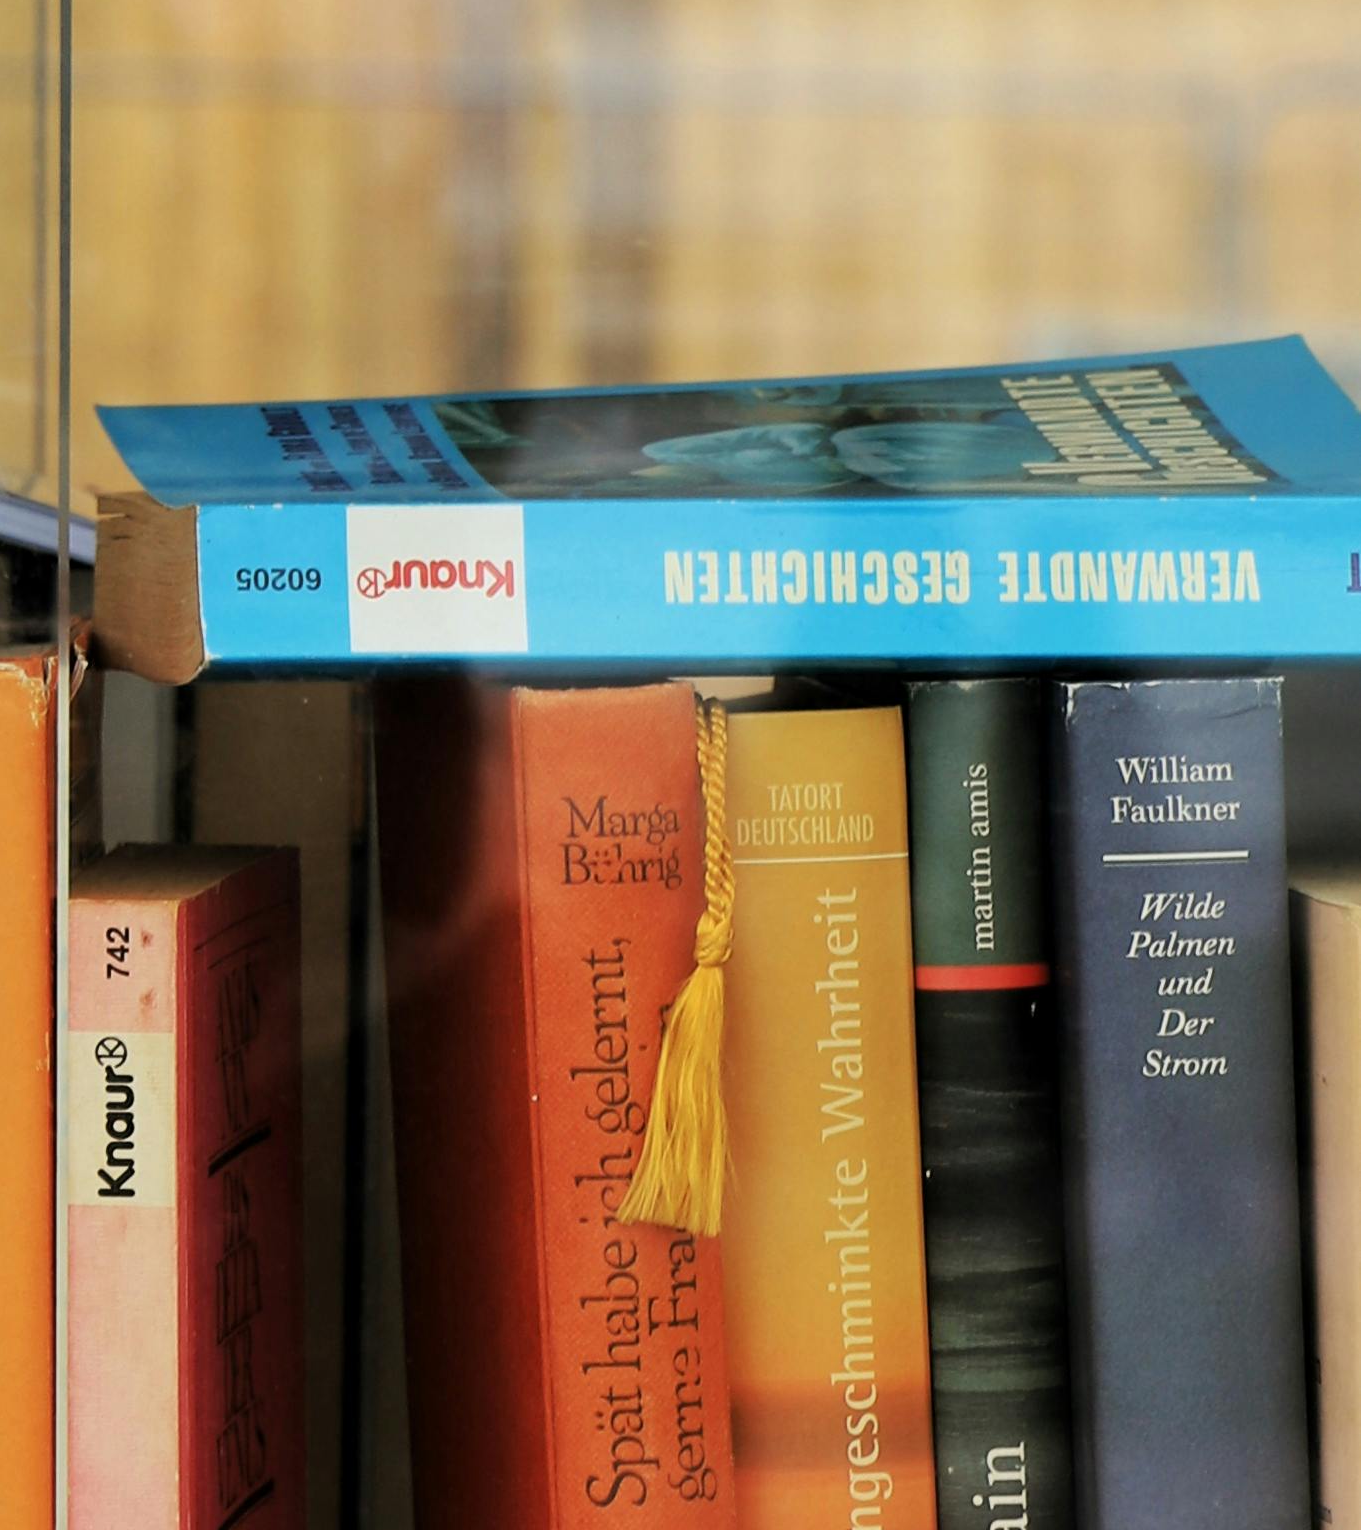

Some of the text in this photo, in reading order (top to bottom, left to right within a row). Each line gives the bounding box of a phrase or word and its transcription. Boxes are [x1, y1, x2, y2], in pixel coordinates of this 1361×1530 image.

[235, 567, 323, 595] 60205
[389, 558, 515, 598] Knaur
[664, 550, 1261, 603] VERWANDTE GESCHICHTEN
[1116, 755, 1234, 786] William
[767, 781, 843, 812] TATORT
[1111, 796, 1240, 824] Faulkner
[736, 814, 874, 846] DEUTSCHLAND
[967, 763, 995, 951] martin amis
[1138, 893, 1226, 922] Wilde
[107, 926, 131, 980] 742
[1127, 932, 1236, 962] Palmen
[1157, 968, 1213, 998] und
[817, 887, 865, 1143] Wahrheit
[1157, 1011, 1214, 1039] Der
[1142, 1048, 1229, 1077] Strom
[98, 1063, 135, 1199] Knaur
